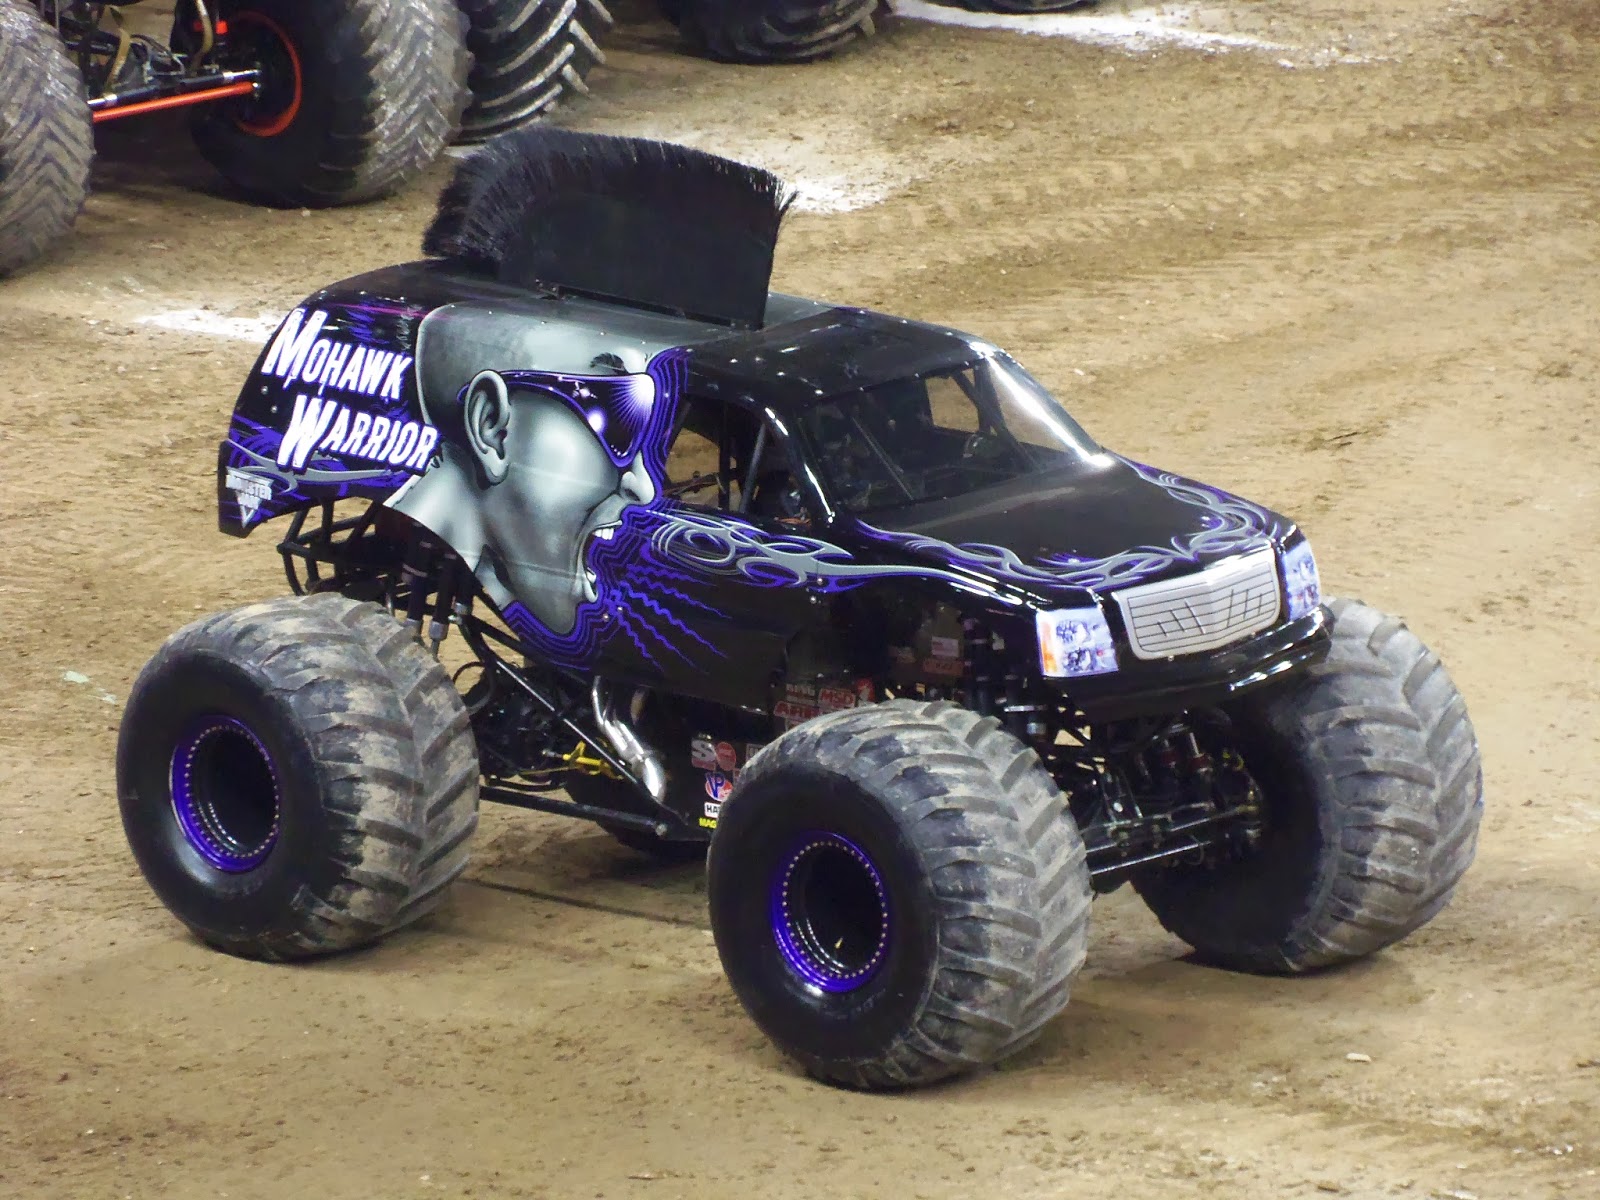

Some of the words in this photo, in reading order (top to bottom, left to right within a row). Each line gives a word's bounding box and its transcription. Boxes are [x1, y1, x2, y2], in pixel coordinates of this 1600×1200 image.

[261, 307, 412, 400] MOHAWK
[277, 394, 438, 471] WARRIOR
[706, 804, 721, 813] HA
